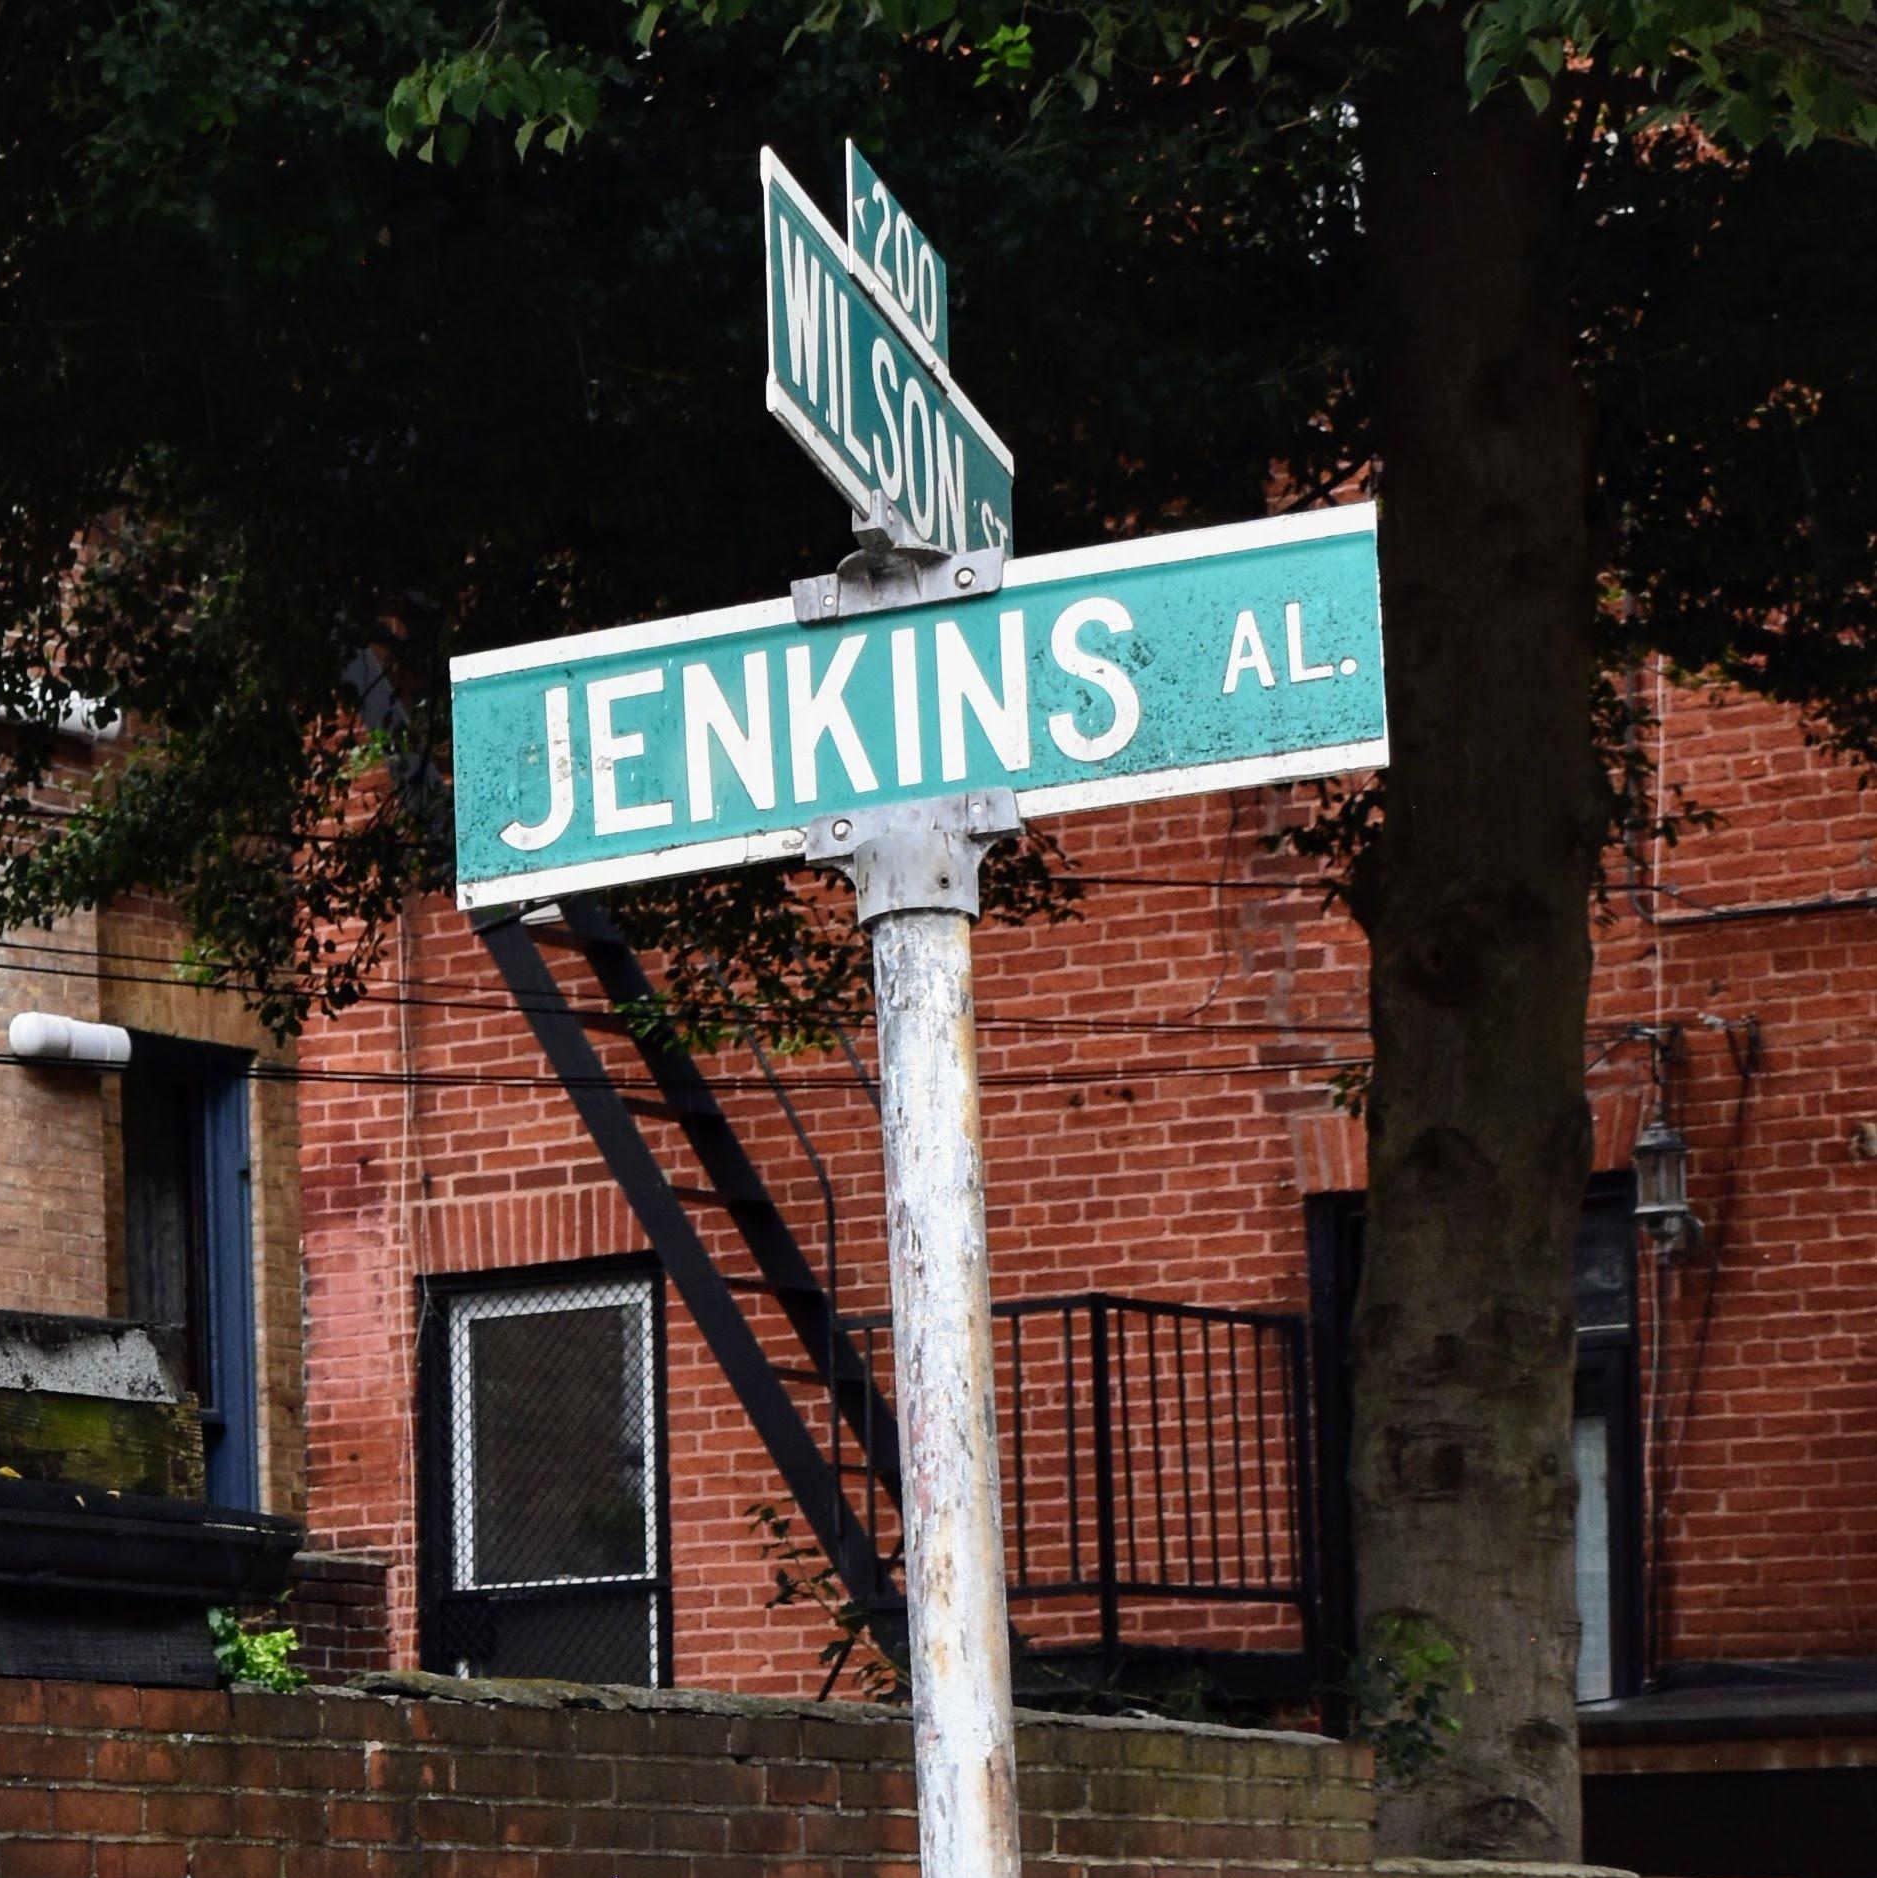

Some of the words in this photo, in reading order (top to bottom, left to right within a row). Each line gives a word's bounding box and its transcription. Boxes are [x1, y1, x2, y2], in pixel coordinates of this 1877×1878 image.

[779, 214, 967, 554] WILSON
[872, 182, 937, 343] 200
[499, 596, 1139, 852] JENKINS
[1222, 601, 1358, 694] AL.
